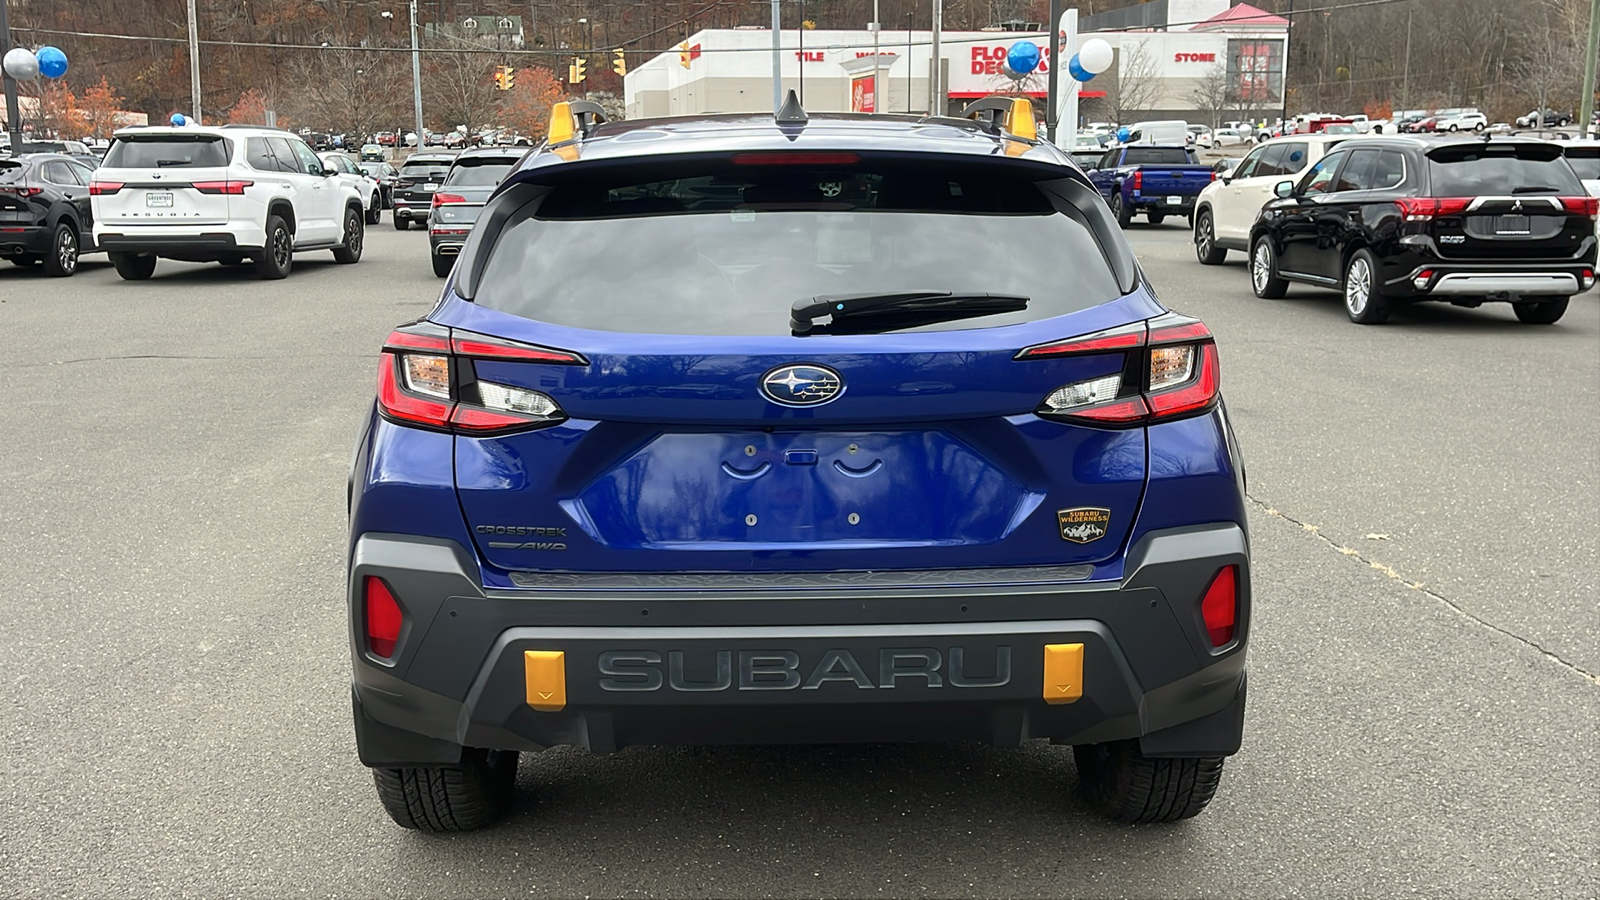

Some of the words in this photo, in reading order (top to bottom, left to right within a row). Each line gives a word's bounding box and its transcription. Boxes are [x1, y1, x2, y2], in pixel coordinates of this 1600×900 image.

[795, 52, 824, 61] TILE
[1175, 53, 1215, 62] STONE
[476, 525, 567, 537] CROSSTREK
[518, 542, 567, 550] AWD
[598, 646, 1012, 692] SUBARU
